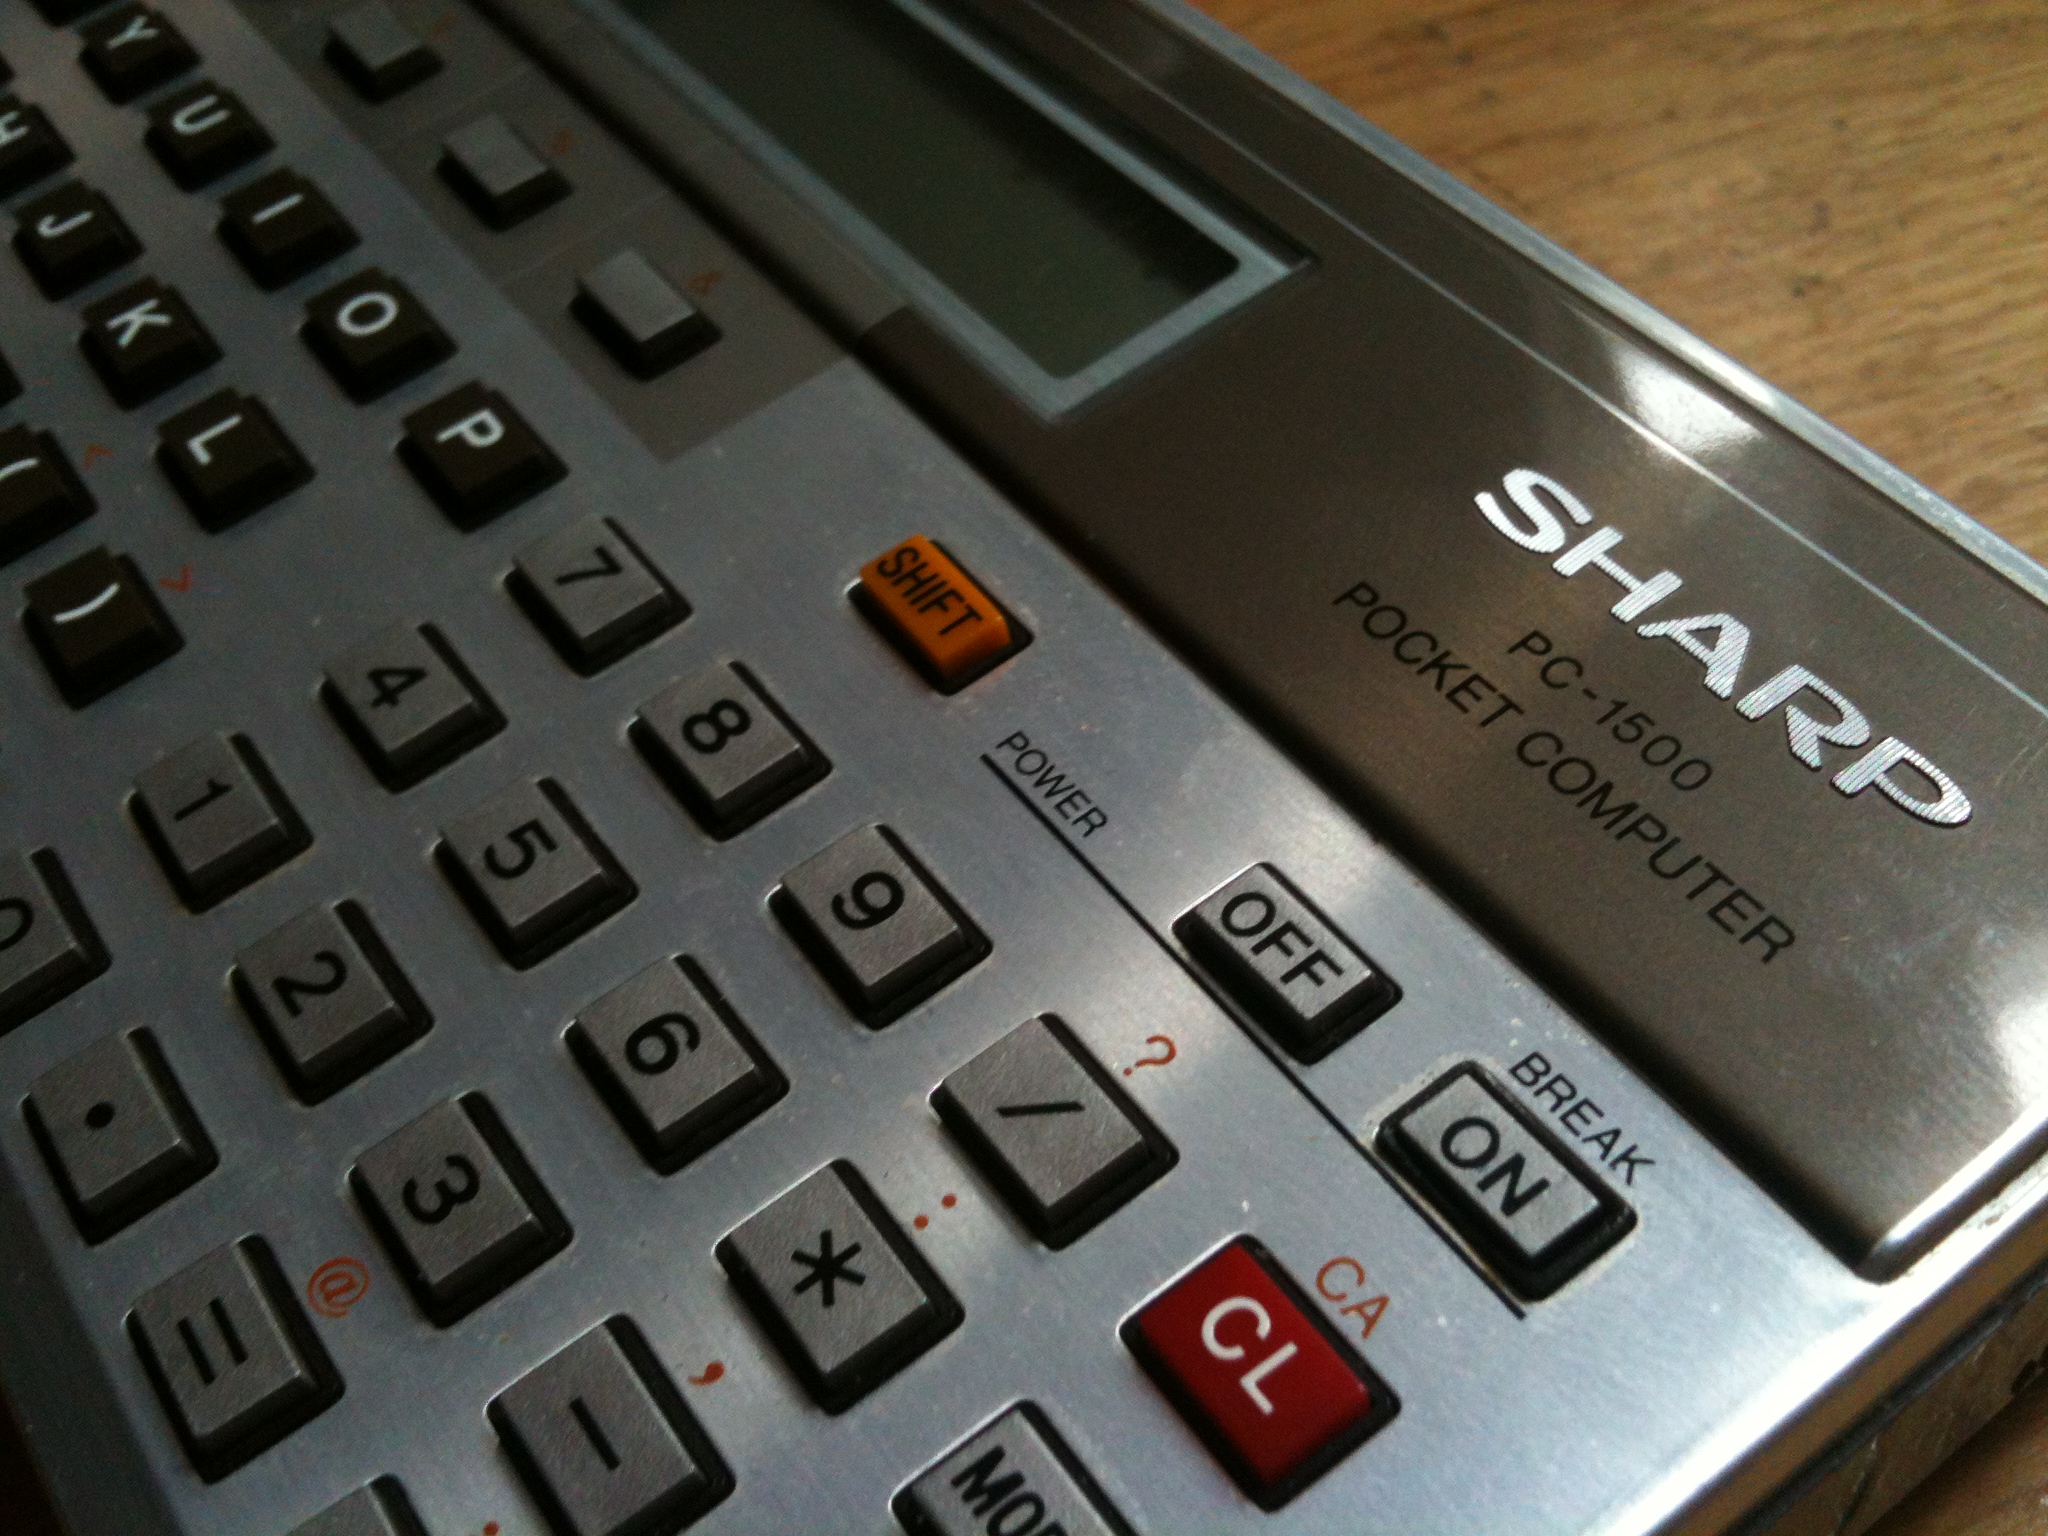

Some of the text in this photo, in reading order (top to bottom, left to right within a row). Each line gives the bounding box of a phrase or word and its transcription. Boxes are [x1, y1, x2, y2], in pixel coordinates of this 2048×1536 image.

[108, 16, 157, 48] Y
[172, 96, 228, 134] U
[38, 212, 92, 237] J
[108, 300, 170, 346] K
[337, 292, 398, 336] O
[188, 415, 241, 464] L
[438, 409, 503, 447] P
[554, 546, 622, 585] 7
[877, 546, 983, 637] SHIFT
[1474, 467, 1973, 827] SHARP
[367, 668, 426, 708] 4
[1507, 629, 1714, 792] PC-1500
[682, 699, 751, 754] 8
[174, 779, 231, 821] 1
[995, 731, 1108, 838] POWER
[1332, 580, 1797, 965] POCKET COMPUTER
[483, 820, 557, 880] 5
[831, 871, 904, 930] 9
[1220, 891, 1344, 989] OFF
[272, 951, 347, 1017] 2
[624, 1013, 700, 1076] 6
[1124, 1034, 1178, 1076] ?
[1508, 1051, 1657, 1186] BREAK
[402, 1155, 479, 1225] 3
[1440, 1116, 1552, 1218] ON
[306, 1256, 370, 1318] @
[1315, 1256, 1390, 1339] CA
[1202, 1297, 1297, 1414] CL
